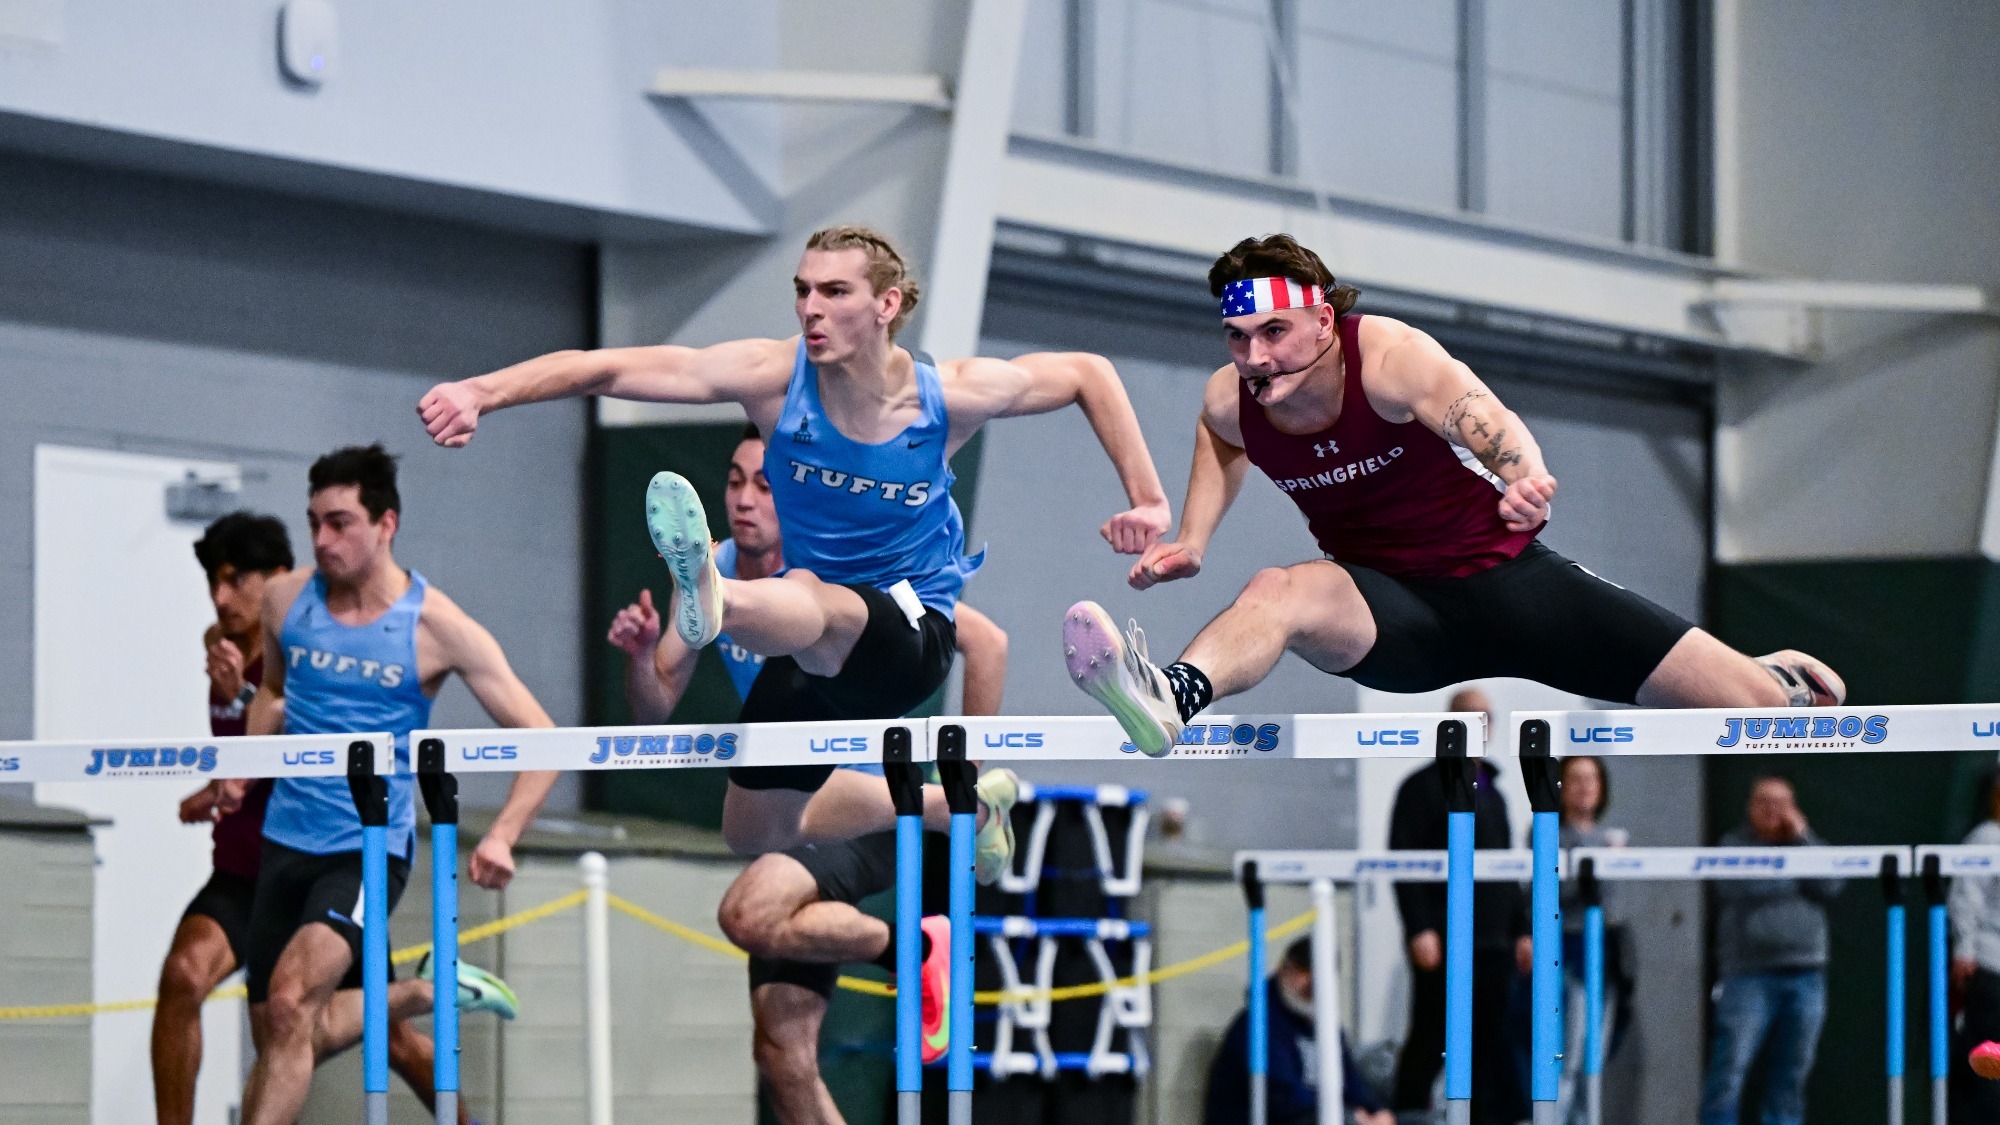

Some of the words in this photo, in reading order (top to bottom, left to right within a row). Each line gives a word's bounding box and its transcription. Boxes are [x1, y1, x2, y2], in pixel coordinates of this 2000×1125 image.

[1275, 446, 1404, 492] SPRINGFIELD
[790, 460, 931, 507] TUFTS
[287, 644, 404, 688] TUFTS
[1570, 727, 1634, 743] UCS
[1716, 715, 1889, 748] JUMBOS
[1972, 721, 2000, 737] U
[810, 737, 868, 753] UCS
[985, 733, 1044, 748] UCS
[1120, 723, 1281, 753] MBOS
[1357, 730, 1419, 746] UCS
[463, 745, 518, 760] UCS
[589, 733, 739, 763] JUMBOS
[0, 757, 20, 771] S
[85, 746, 218, 775] JUMBOS
[283, 751, 335, 765] UCS
